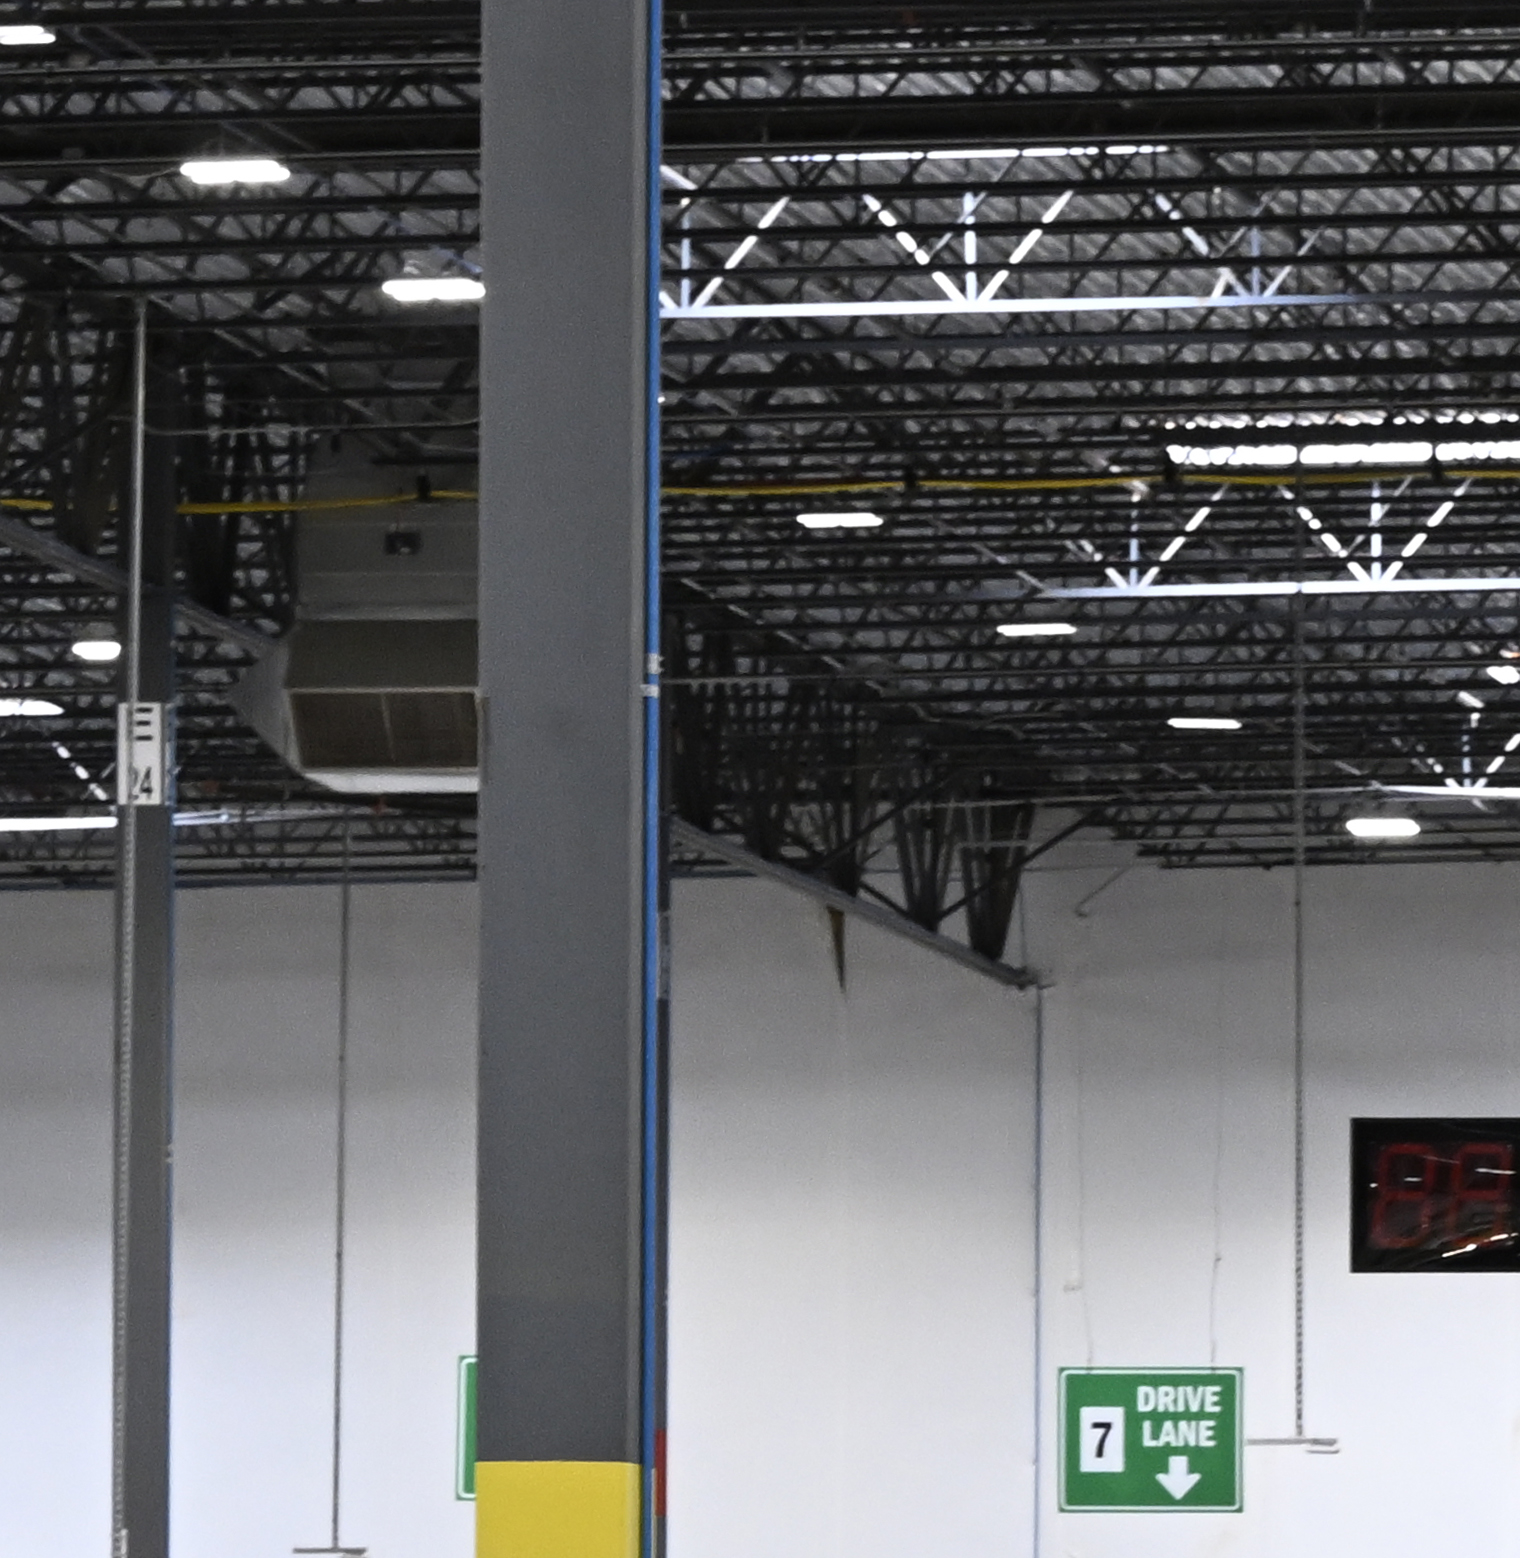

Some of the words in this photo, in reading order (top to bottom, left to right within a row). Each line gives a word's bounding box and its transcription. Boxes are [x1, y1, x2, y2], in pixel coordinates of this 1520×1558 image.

[1136, 1385, 1222, 1413] DRIVE
[1090, 1421, 1113, 1458] 7
[1142, 1420, 1217, 1447] LANE
